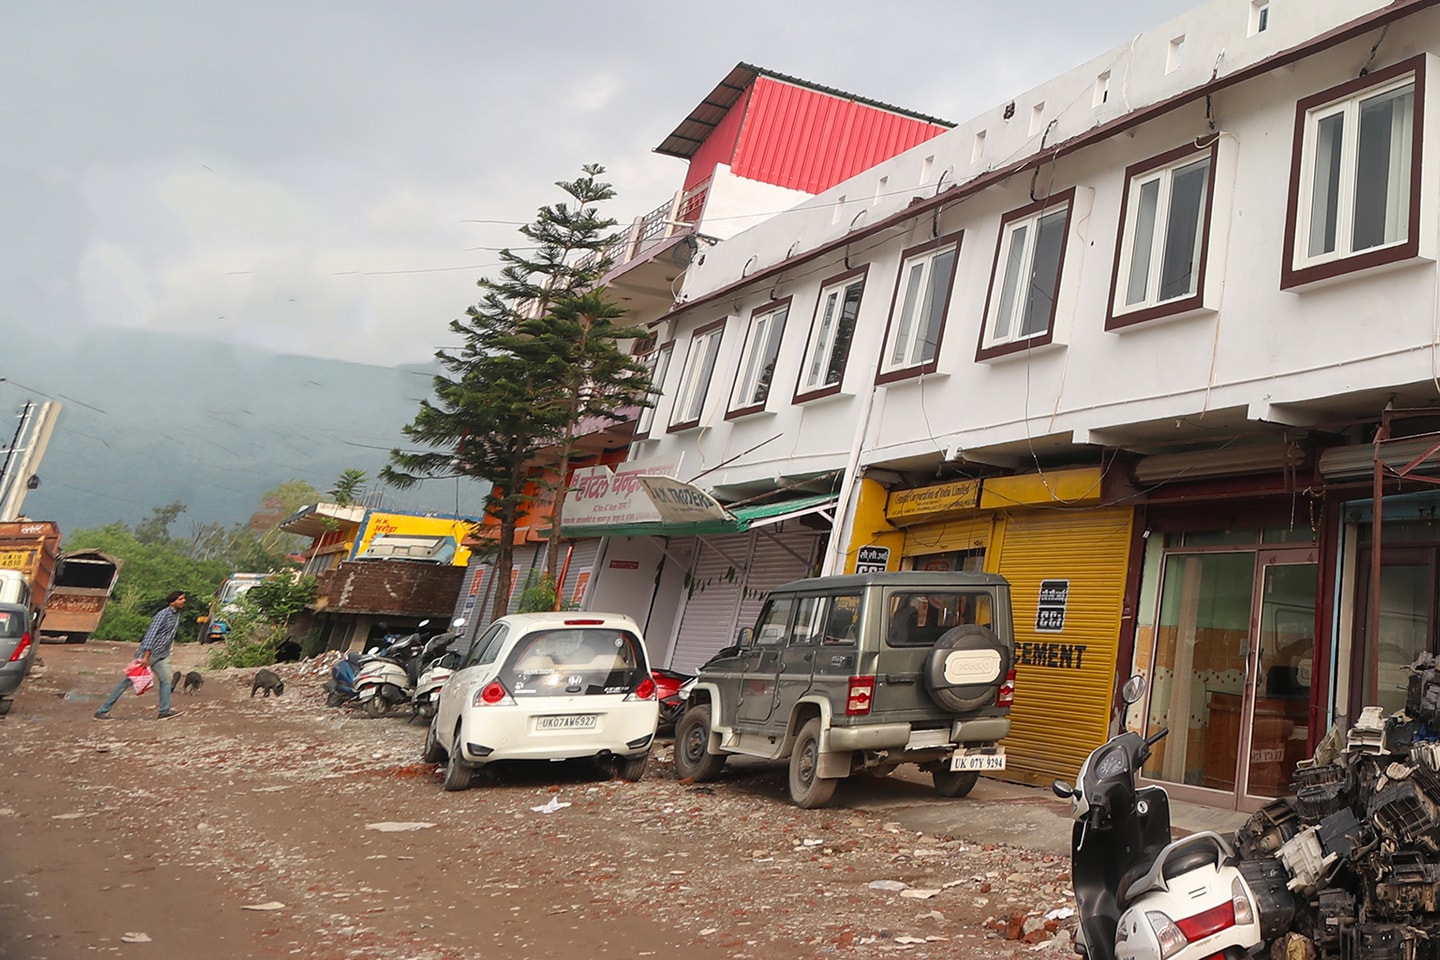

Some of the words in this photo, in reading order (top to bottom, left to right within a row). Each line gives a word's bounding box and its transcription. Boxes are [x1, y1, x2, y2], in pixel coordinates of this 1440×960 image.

[1014, 642, 1087, 669] CEMENT
[542, 716, 596, 728] UK07AW6927
[955, 758, 966, 769] UK
[970, 758, 985, 769] 07Y
[986, 757, 1003, 769] 9294
